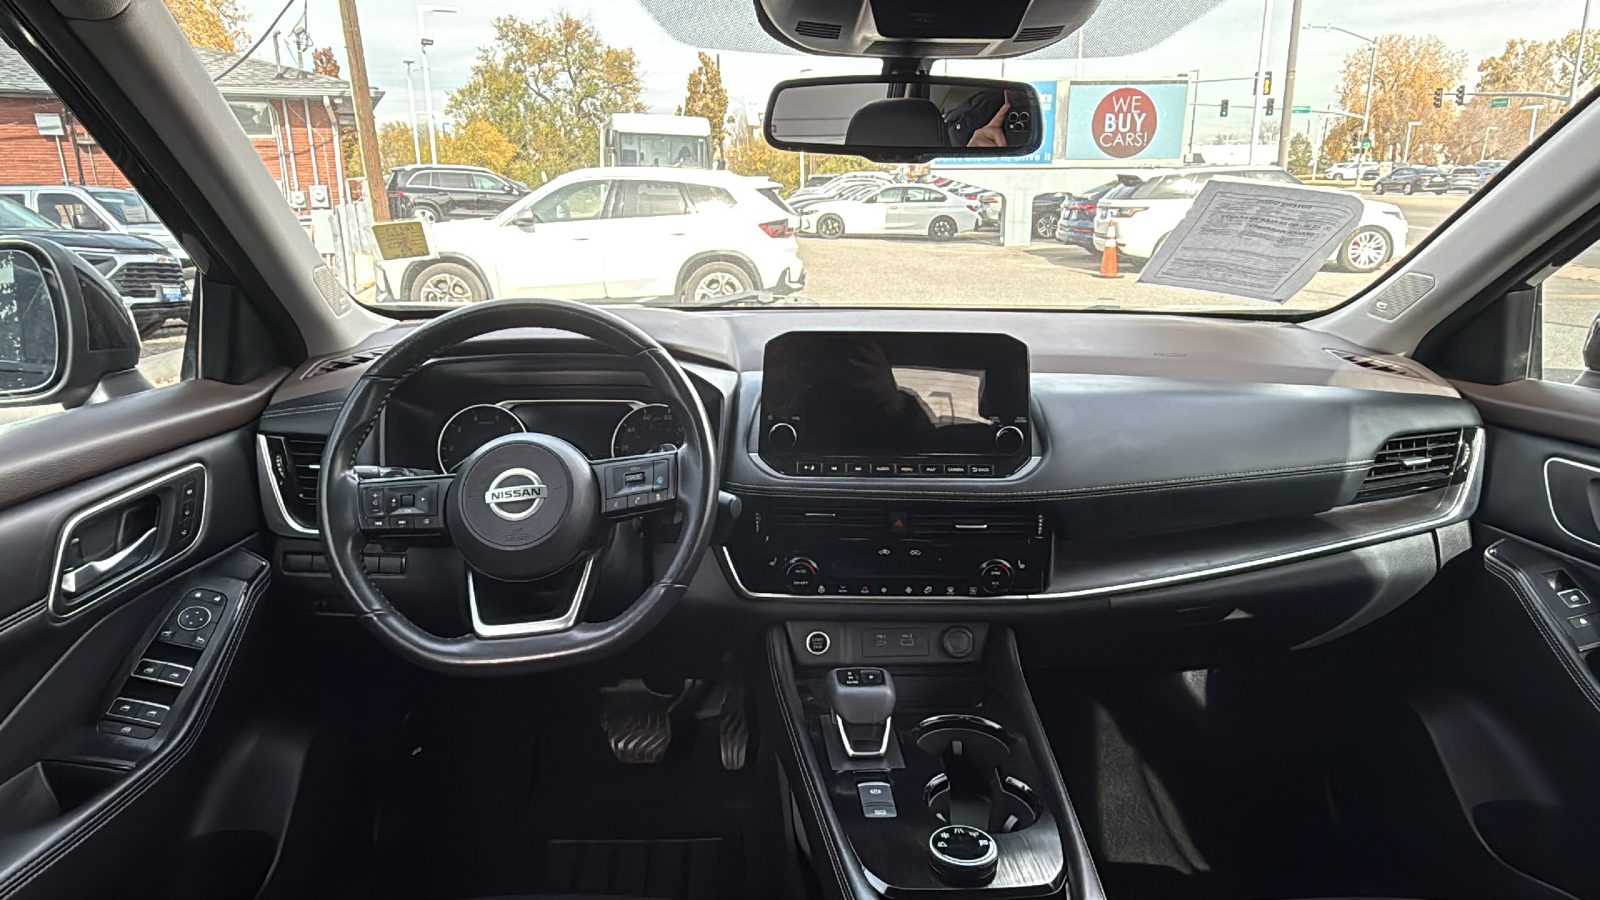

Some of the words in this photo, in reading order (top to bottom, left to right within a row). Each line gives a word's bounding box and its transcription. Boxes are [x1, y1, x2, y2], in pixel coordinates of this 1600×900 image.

[1112, 95, 1142, 113] WE
[1104, 112, 1147, 133] BUY
[1099, 131, 1148, 147] CARS!
[626, 473, 643, 481] CANCEL
[491, 488, 541, 501] NISSAN
